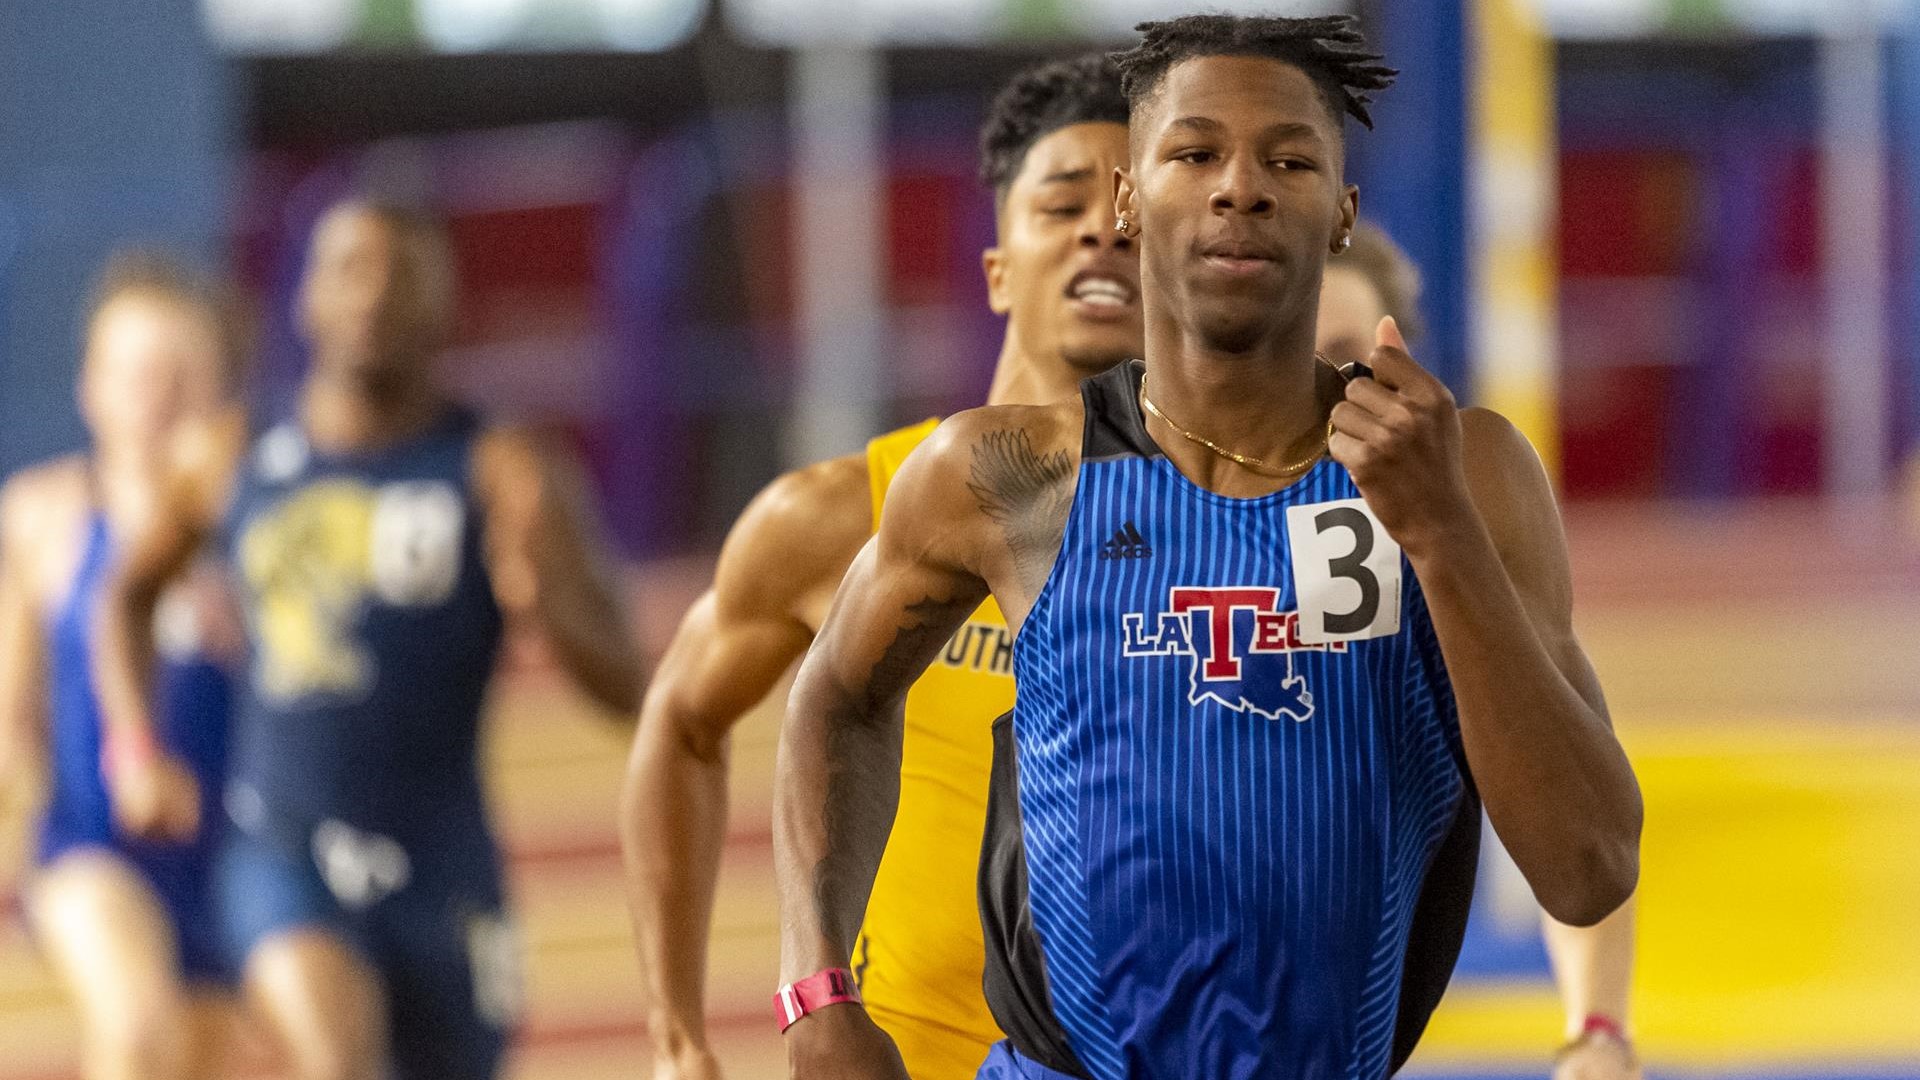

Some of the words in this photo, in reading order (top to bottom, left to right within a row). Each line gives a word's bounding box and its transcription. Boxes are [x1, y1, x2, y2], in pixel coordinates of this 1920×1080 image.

[1099, 545, 1153, 560] adidas
[1314, 506, 1381, 635] 3
[1123, 612, 1193, 657] LA
